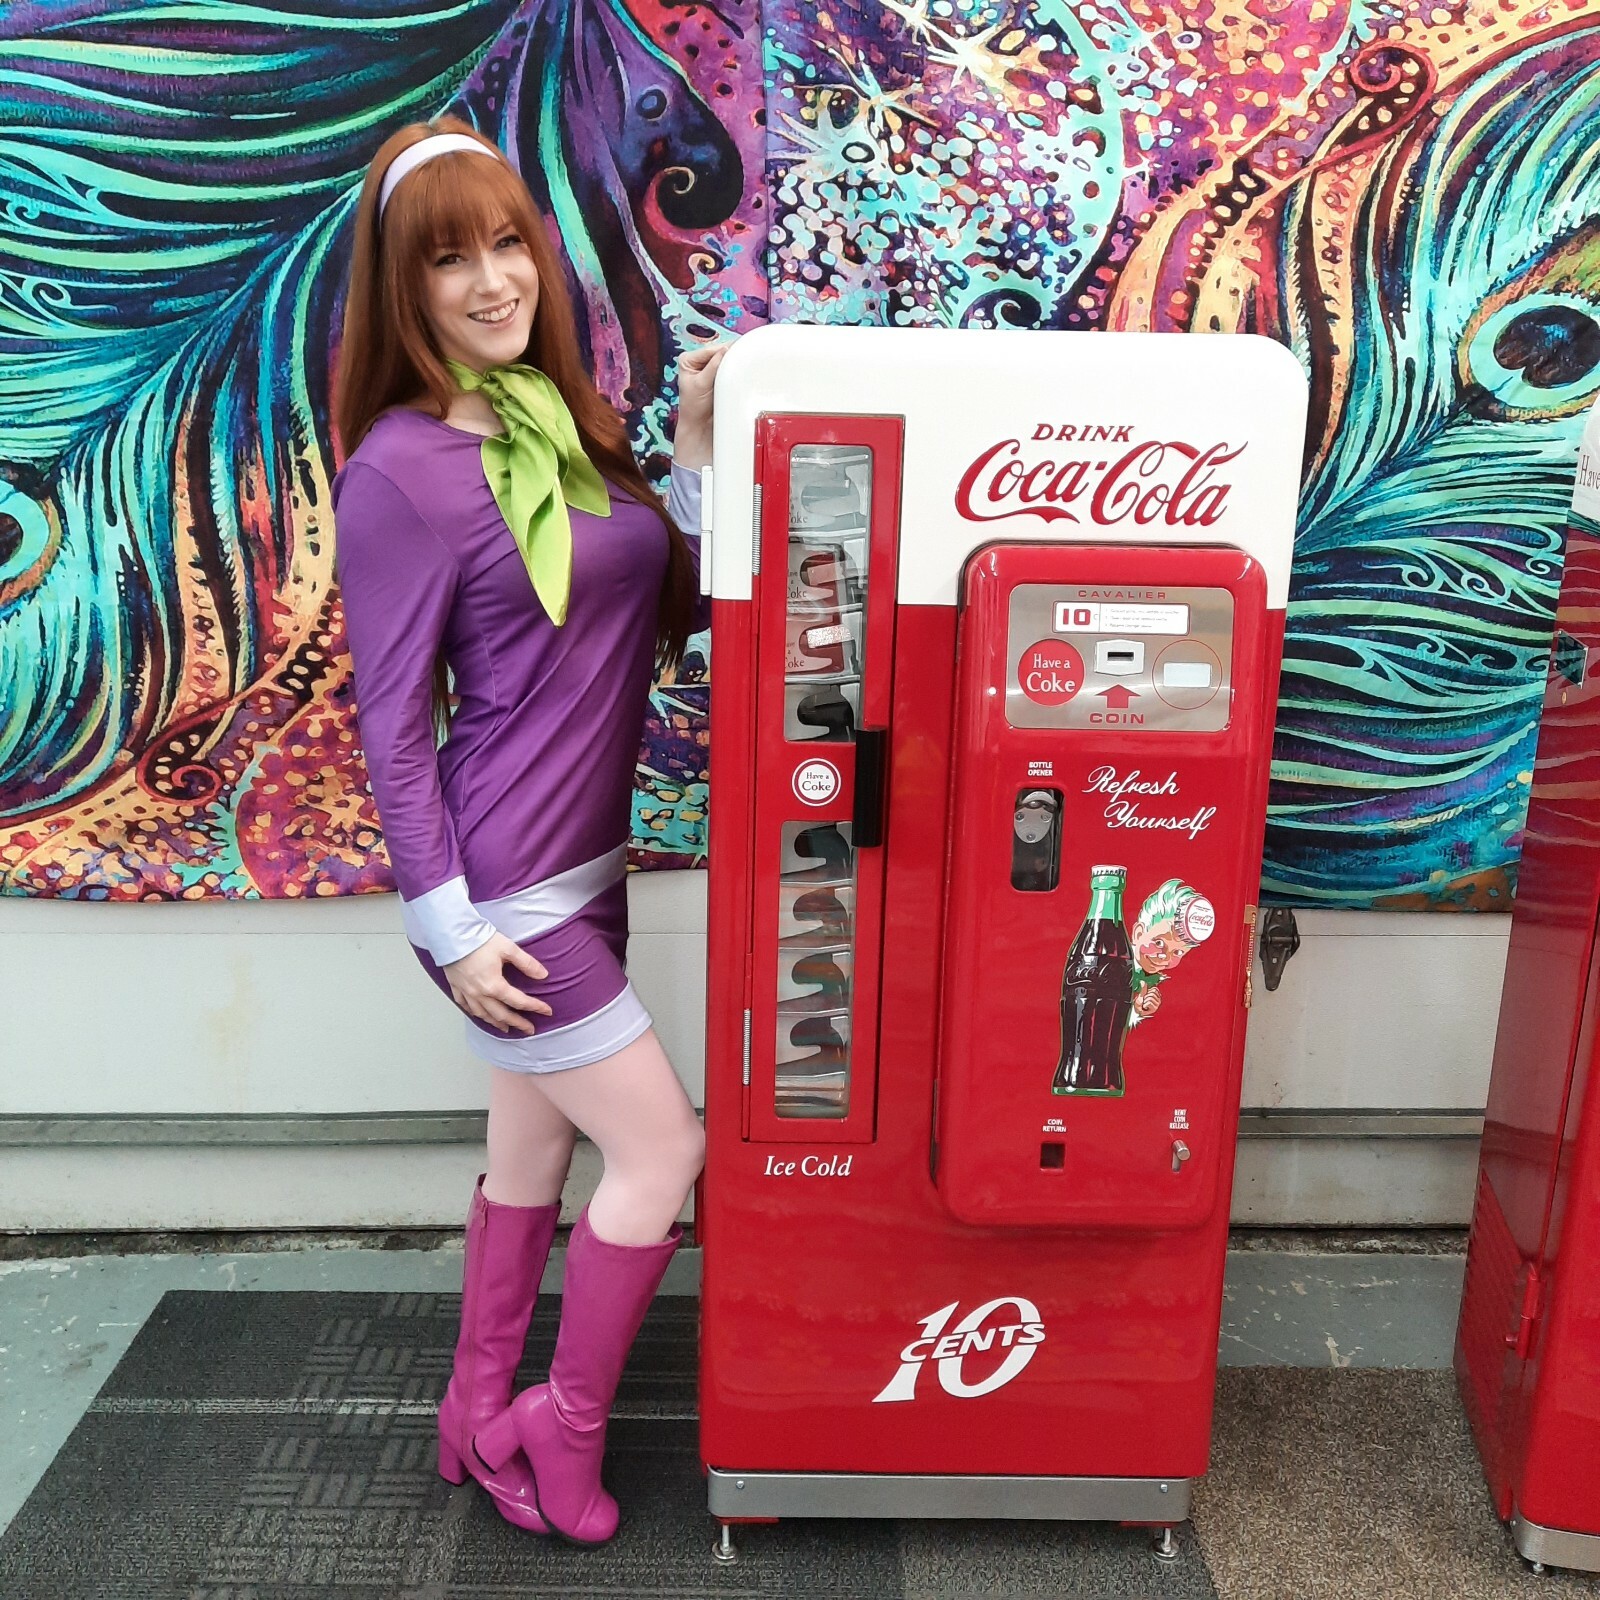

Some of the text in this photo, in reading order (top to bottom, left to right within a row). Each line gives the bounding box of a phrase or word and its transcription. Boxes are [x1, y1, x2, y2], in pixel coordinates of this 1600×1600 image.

[1030, 423, 1135, 443] DRINK
[954, 438, 1249, 527] Coca-Cola
[1078, 589, 1167, 600] CAVALIER
[1062, 608, 1092, 626] 10
[1033, 653, 1071, 669] Have a
[1026, 672, 1076, 693] Coke
[1089, 712, 1144, 725] COIN
[1027, 769, 1054, 777] OPENER
[1028, 761, 1053, 769] BOTTLE
[806, 772, 824, 780] Have
[1082, 765, 1180, 803] Refresh
[801, 780, 831, 791] Coke
[1103, 801, 1217, 840] Yourself
[1042, 1125, 1067, 1133] RETURN
[764, 1155, 853, 1177] Ice Cold
[872, 1297, 1042, 1403] 10
[900, 1323, 1046, 1363] CENTS
